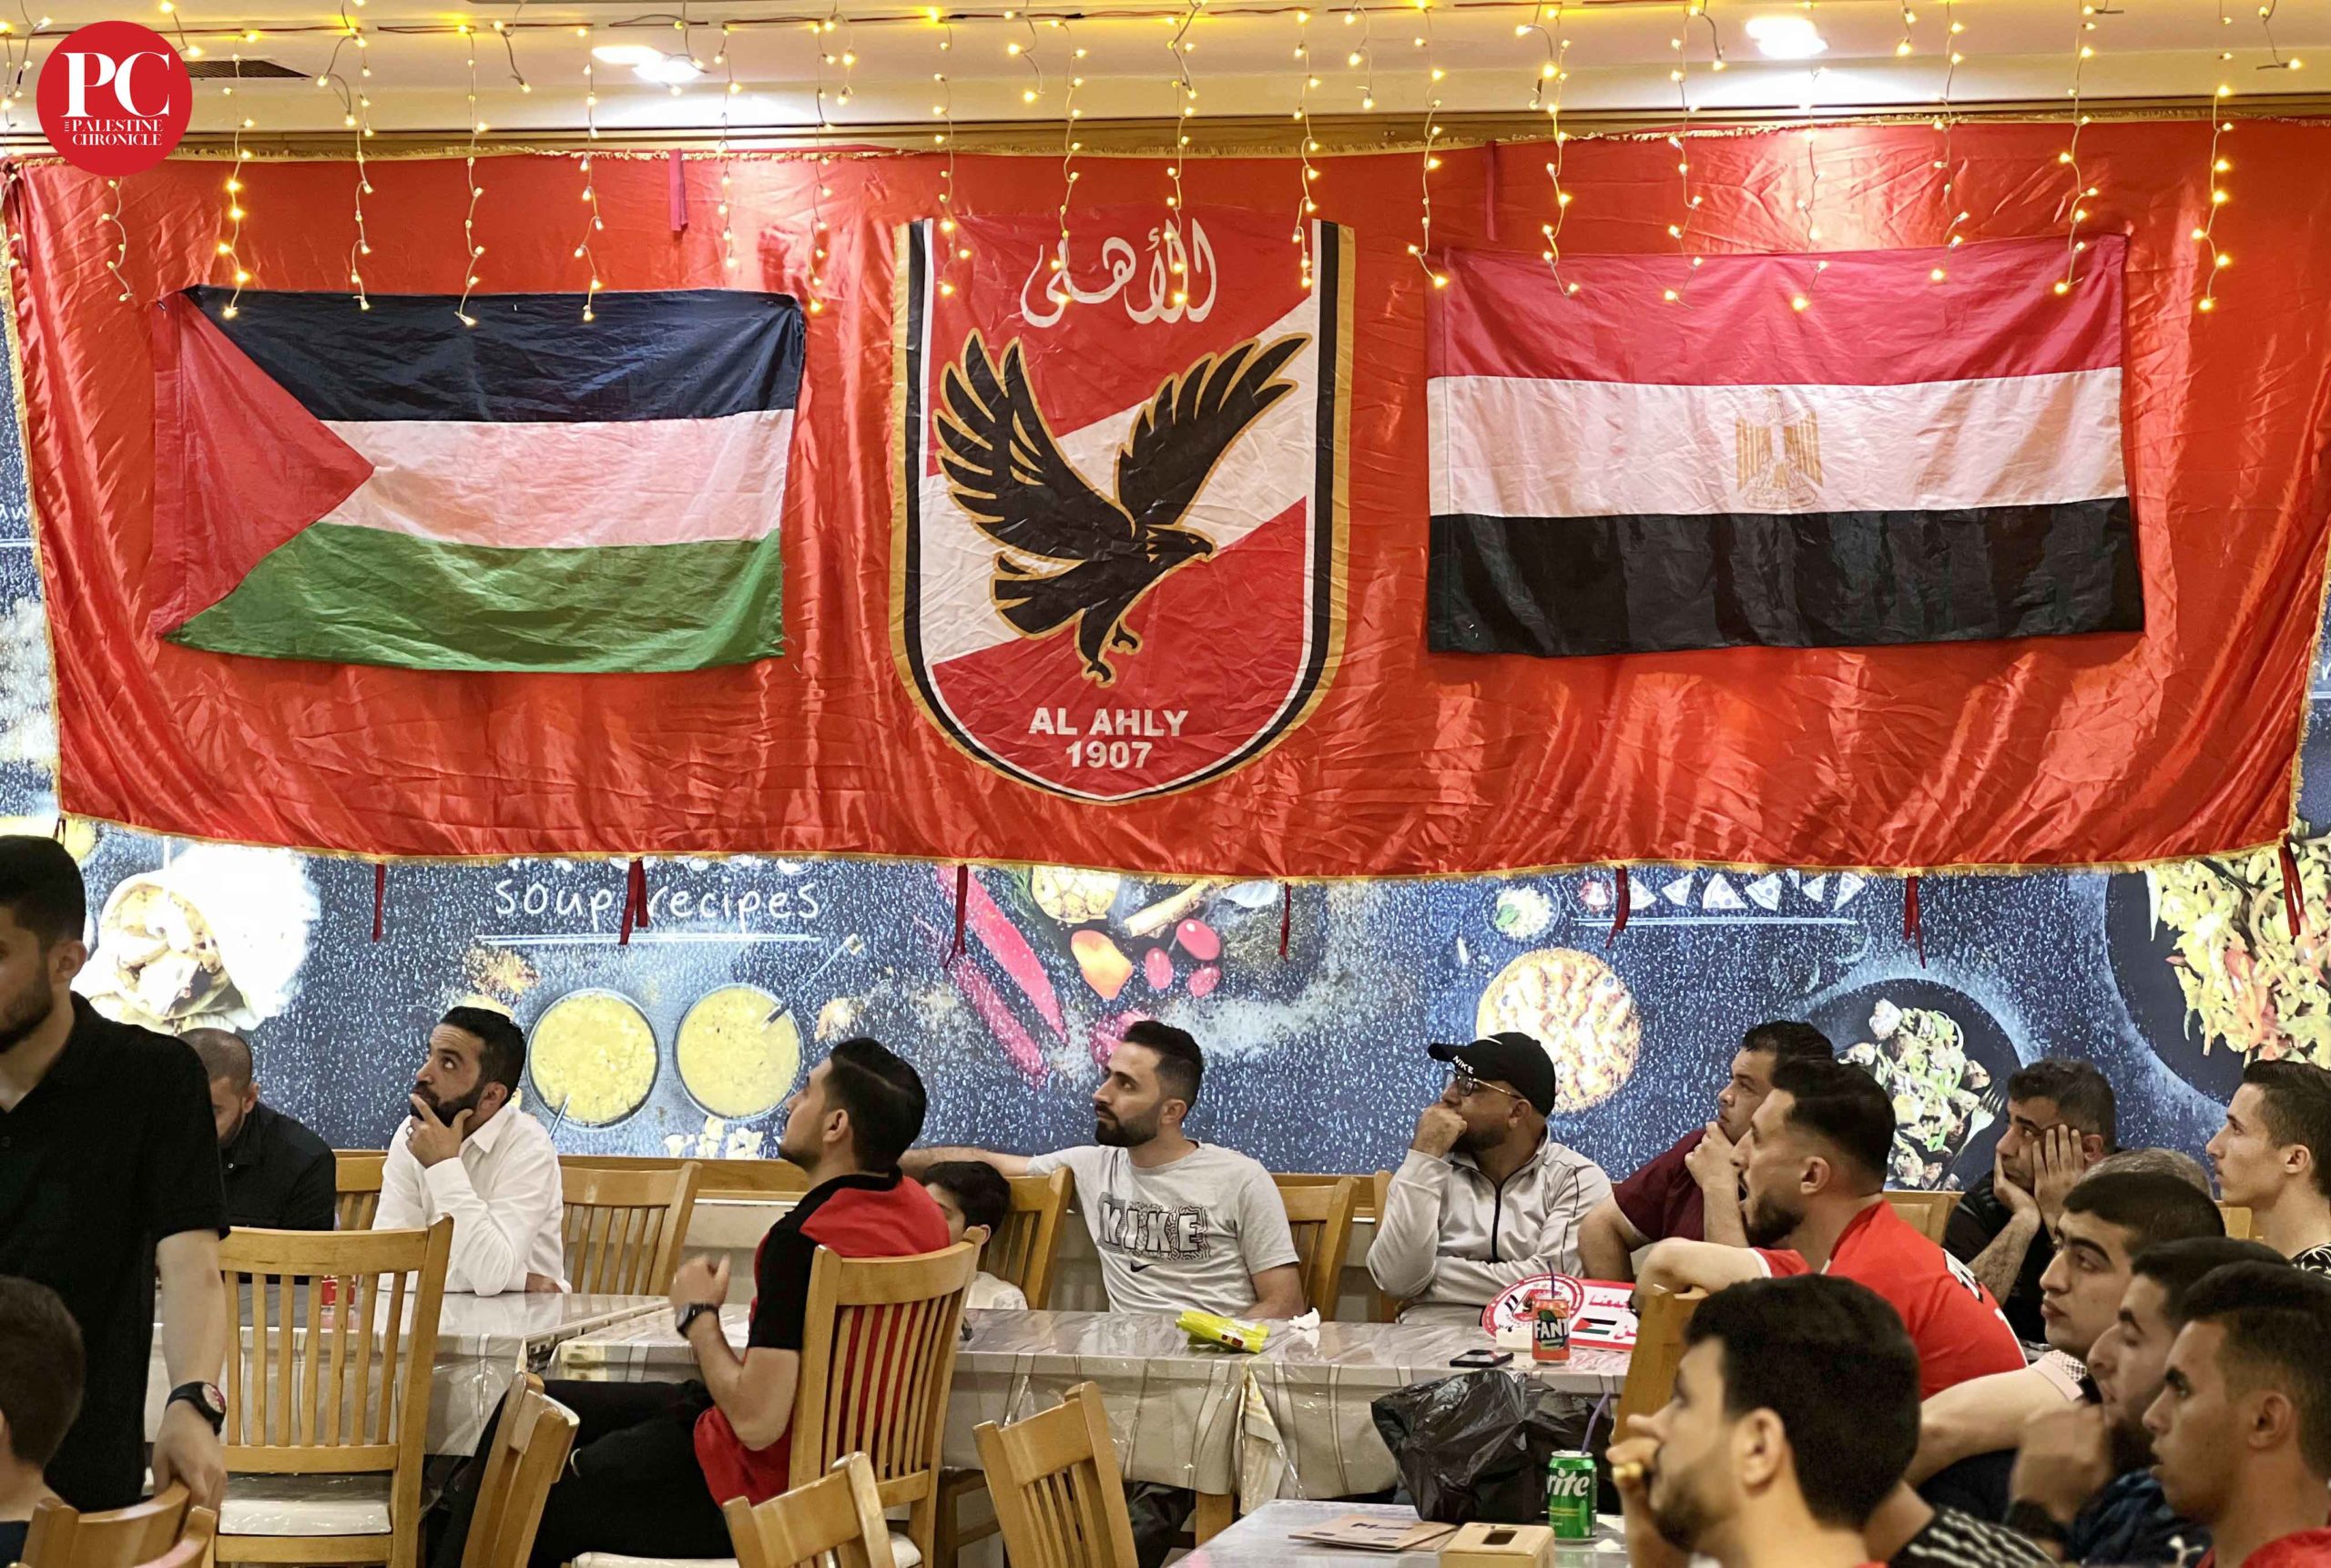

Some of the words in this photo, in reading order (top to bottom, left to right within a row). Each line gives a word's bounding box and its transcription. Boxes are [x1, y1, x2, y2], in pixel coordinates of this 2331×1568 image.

[1028, 707, 1078, 735] AL
[1088, 708, 1189, 737] AHLY
[1065, 740, 1153, 769] 1907
[1451, 1054, 1474, 1074] NIKE
[1533, 1319, 1570, 1339] FANT
[1547, 1467, 1590, 1497] rite
